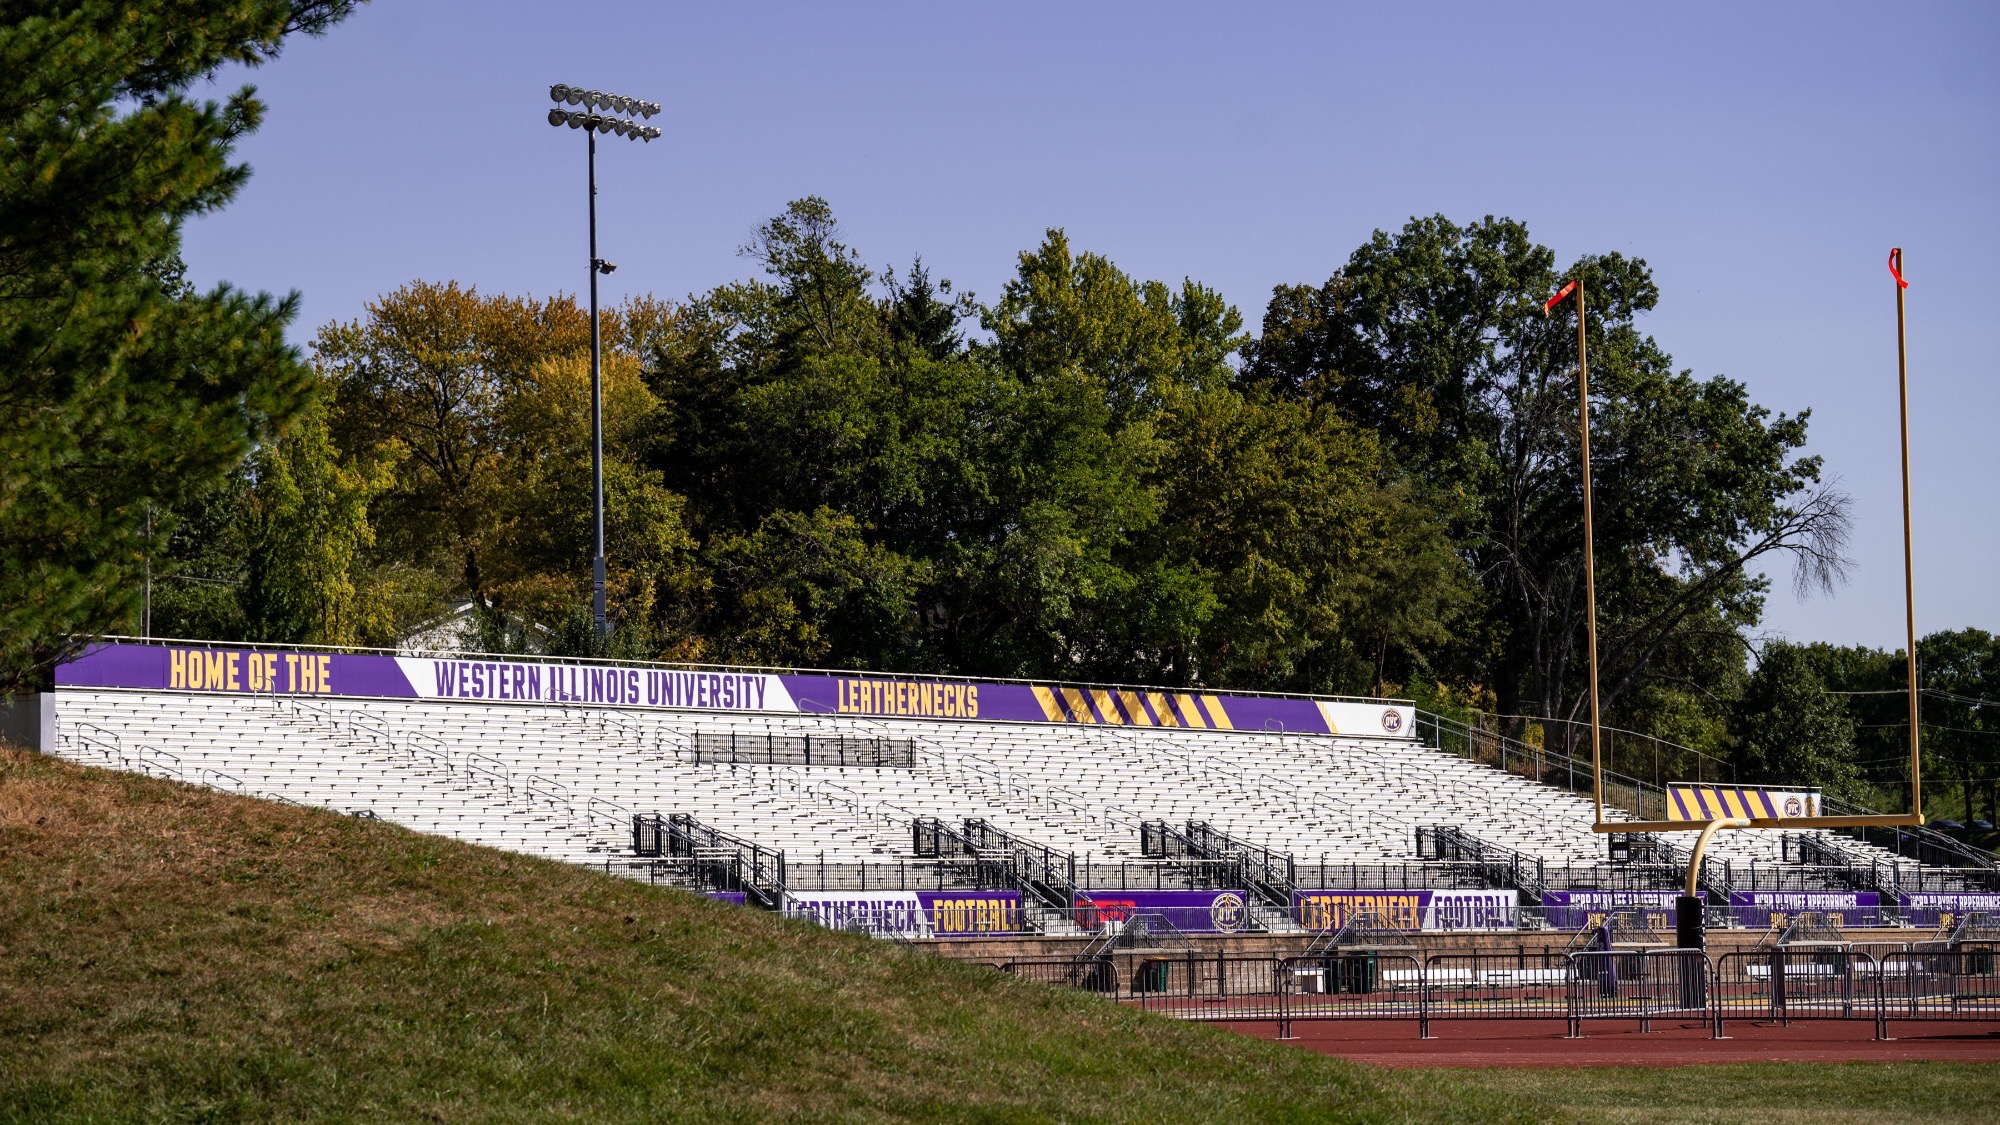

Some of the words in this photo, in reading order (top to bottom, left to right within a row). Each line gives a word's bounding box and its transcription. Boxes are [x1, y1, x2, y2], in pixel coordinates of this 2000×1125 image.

[170, 650, 240, 690] HOME
[248, 653, 278, 692] OF
[286, 654, 332, 693] THE
[433, 661, 541, 700] WESTERN
[548, 666, 640, 704] ILLINOIS
[647, 671, 767, 709] UNIVERSITY
[837, 679, 979, 718] LEATHERNECKS
[932, 899, 1021, 933] FOOTBALL
[1434, 895, 1514, 928] FOOTBALL
[1774, 894, 1806, 910] PLAYOFF
[1807, 894, 1857, 910] APPEARANCES
